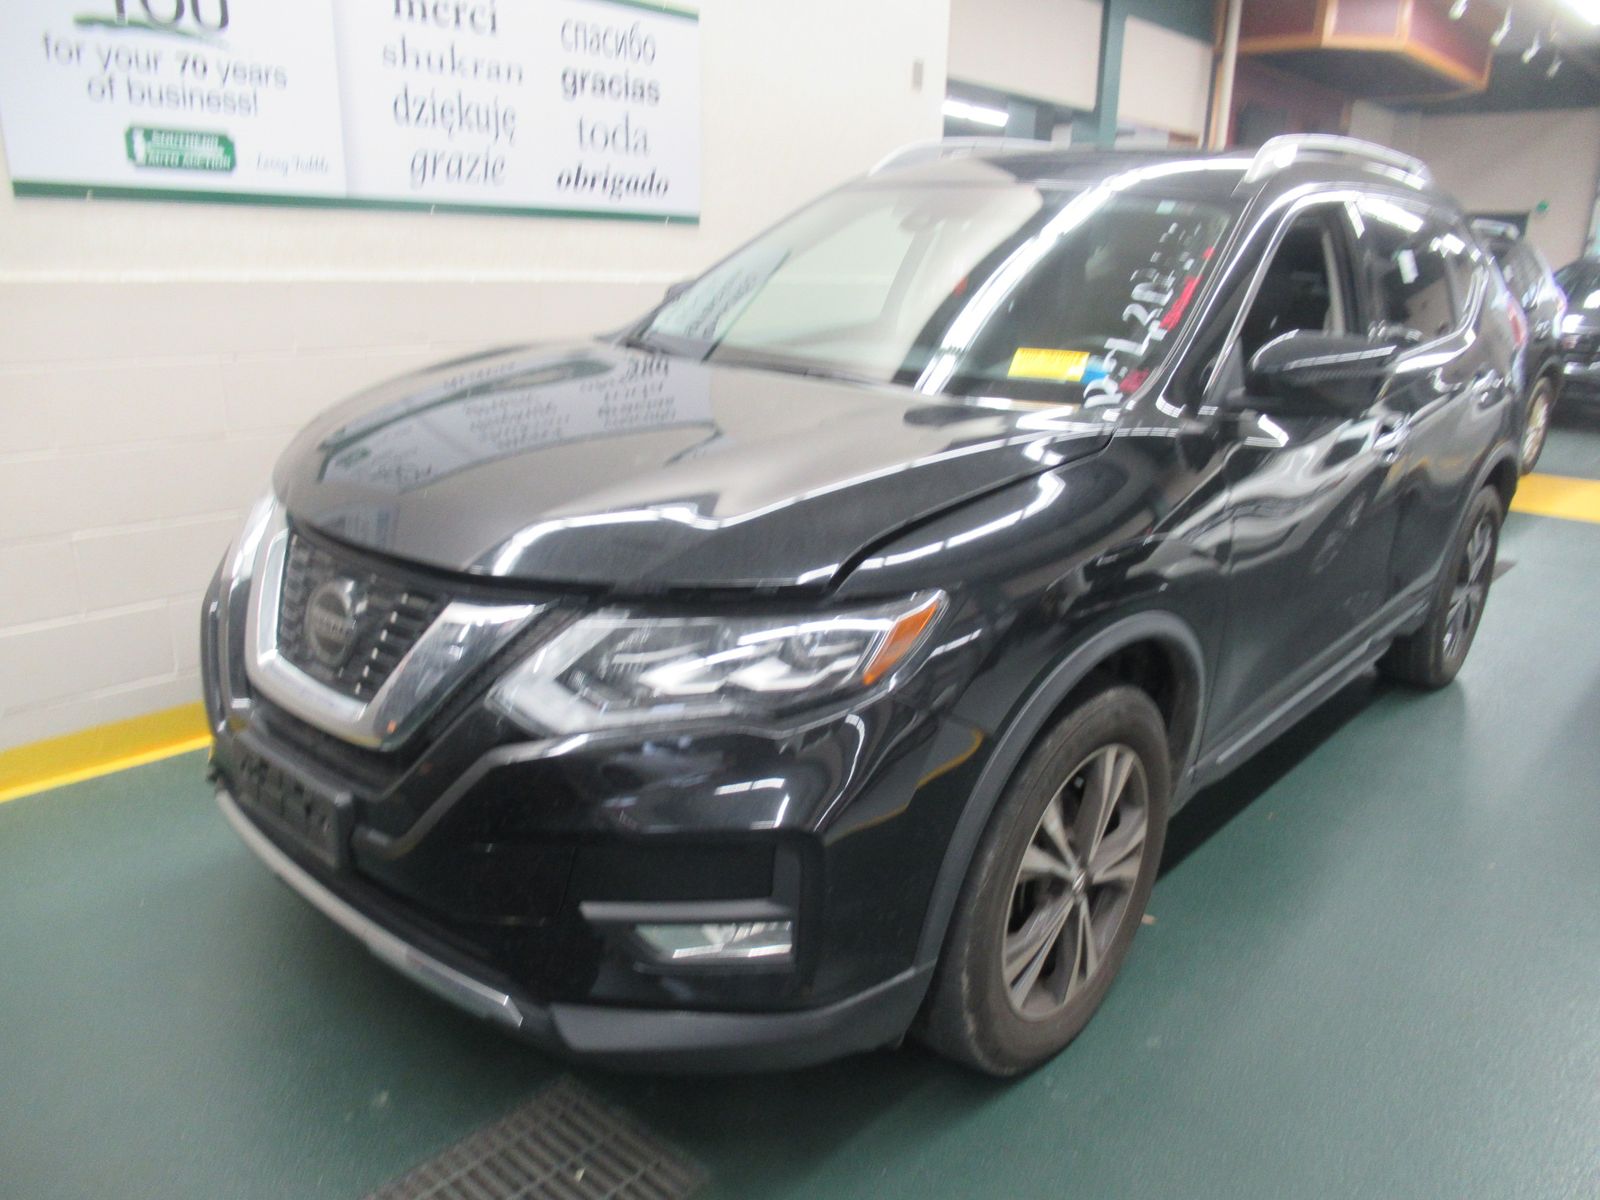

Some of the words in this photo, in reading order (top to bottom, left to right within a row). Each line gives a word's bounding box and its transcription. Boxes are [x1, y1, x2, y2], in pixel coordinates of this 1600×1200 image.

[393, 0, 498, 36] merci
[43, 31, 84, 64] for
[97, 45, 163, 74] your
[175, 51, 208, 76] 70
[217, 62, 288, 89] years
[382, 33, 524, 85] shukran
[560, 17, 657, 66] спасибо
[87, 74, 116, 103] of
[127, 78, 259, 116] business!
[560, 65, 661, 106] gracias
[577, 112, 650, 155] toda
[410, 146, 505, 190] grazie
[556, 162, 670, 200] obrigado
